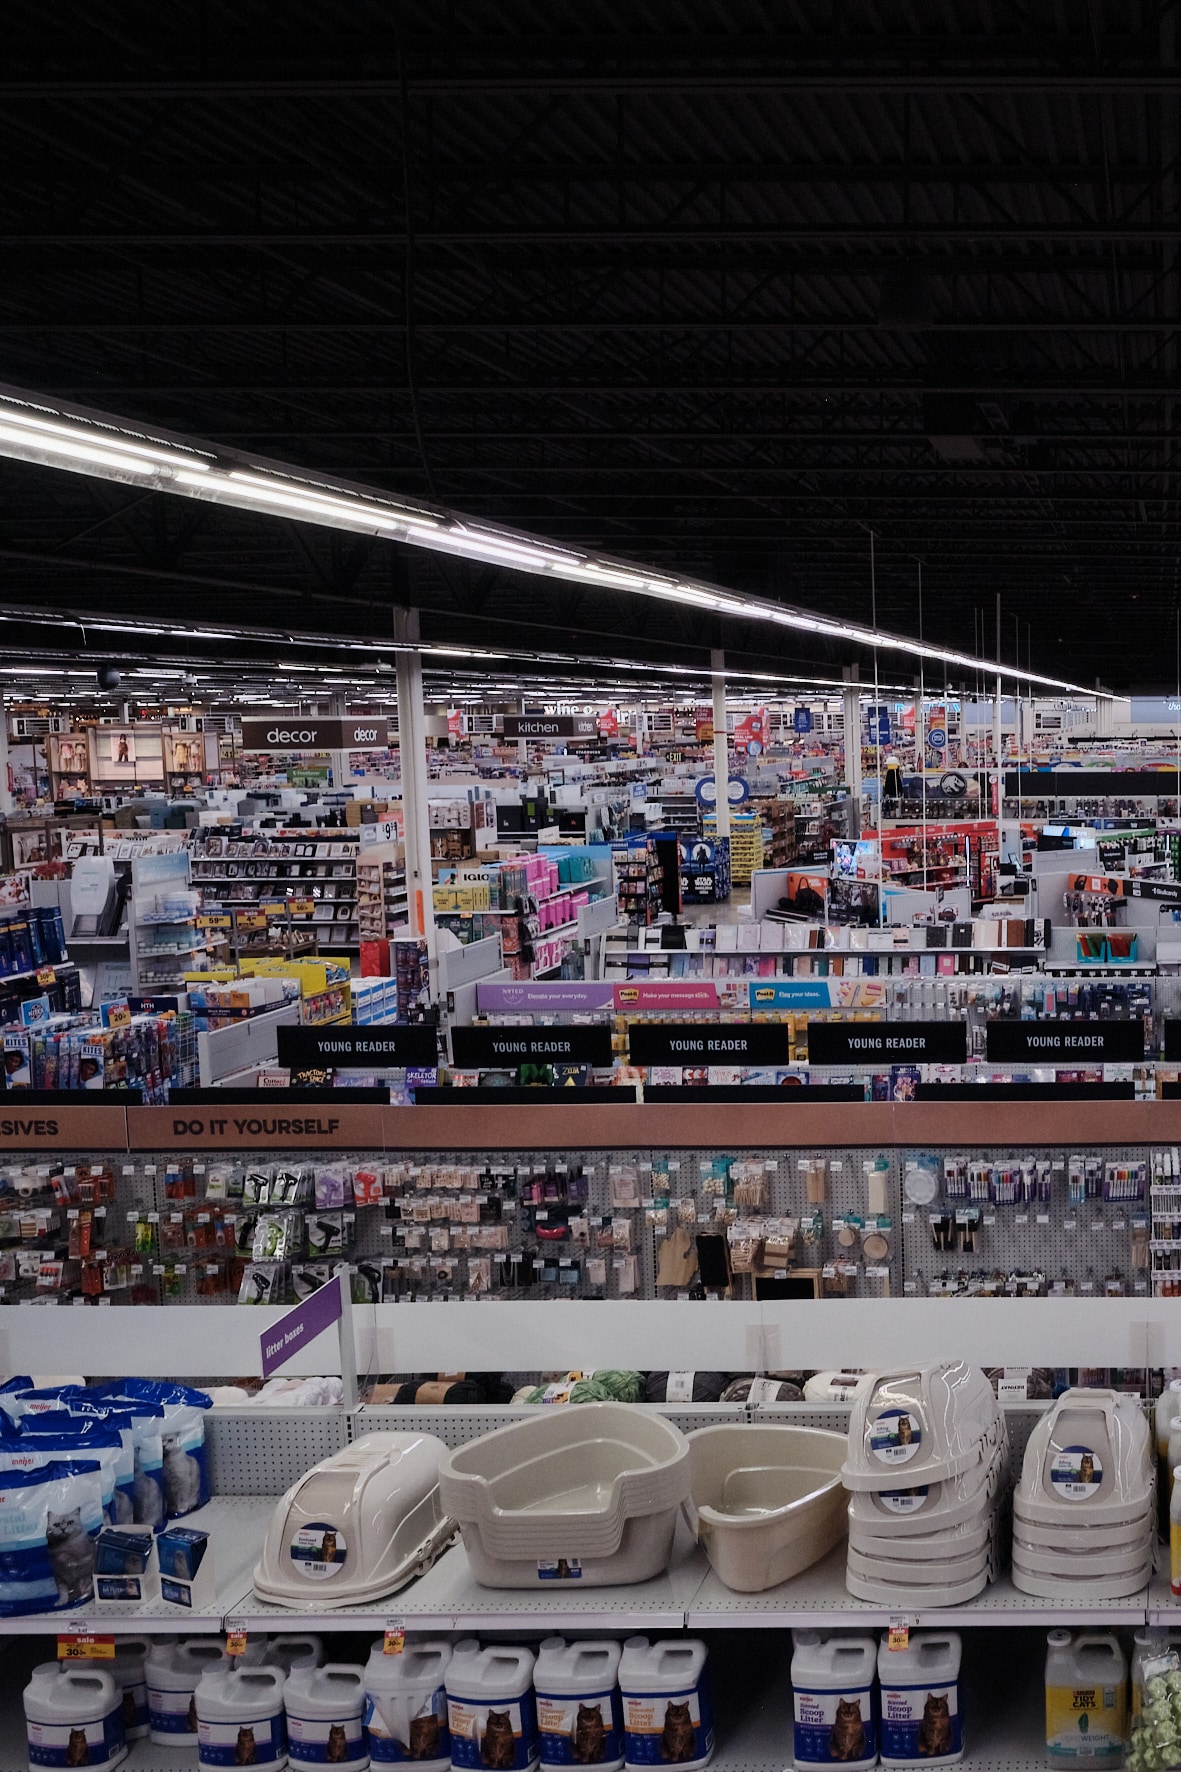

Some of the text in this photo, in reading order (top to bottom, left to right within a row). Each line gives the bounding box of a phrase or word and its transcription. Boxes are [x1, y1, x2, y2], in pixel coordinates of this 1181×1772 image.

[544, 704, 582, 715] wine
[518, 721, 559, 734] kitchen
[266, 728, 318, 744] decor
[354, 727, 378, 742] decor
[670, 752, 682, 762] EXIT
[779, 991, 790, 999] Flag
[5, 1038, 28, 1048] KITES
[317, 1040, 397, 1052] YOUNG READER
[669, 1039, 748, 1051] YOUNG READER
[848, 1037, 926, 1049] YOUNG READER
[1026, 1035, 1104, 1047] YOUNG READER
[81, 1045, 104, 1056] KITES
[492, 1041, 571, 1053] YOUNG READER
[407, 1072, 437, 1080] SKELETON
[0, 1119, 59, 1135] SIVES
[173, 1118, 340, 1135] DO IT YOURSELF
[265, 1321, 304, 1359] litter boxes
[29, 1403, 51, 1411] meijer
[76, 1636, 95, 1644] sale
[800, 1708, 825, 1717] Scoop
[887, 1705, 913, 1714] Scoop
[451, 1716, 471, 1724] Scoop
[540, 1712, 563, 1721] Scoop
[628, 1712, 653, 1720] Scoop
[800, 1715, 823, 1723] Litter
[887, 1711, 911, 1720] Litter
[629, 1718, 651, 1726] Litter
